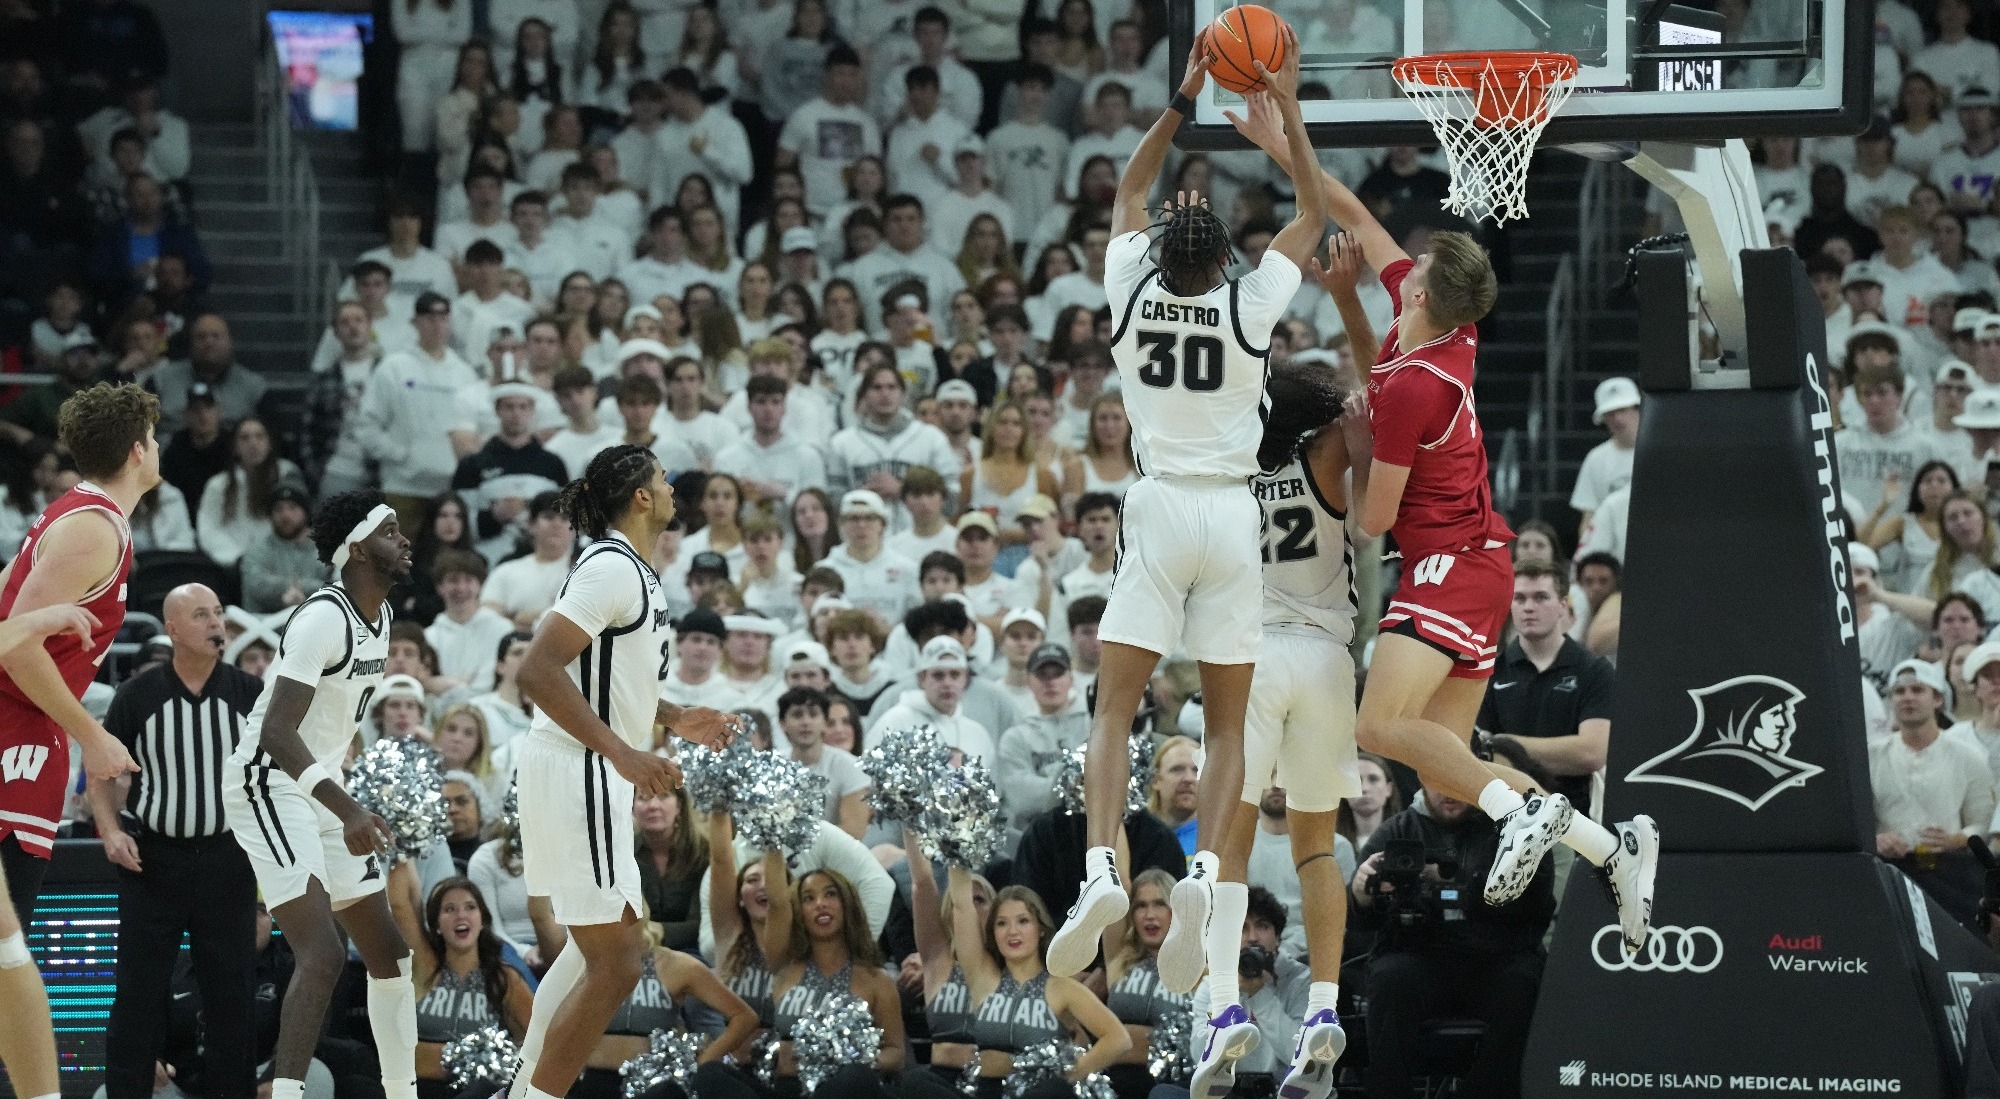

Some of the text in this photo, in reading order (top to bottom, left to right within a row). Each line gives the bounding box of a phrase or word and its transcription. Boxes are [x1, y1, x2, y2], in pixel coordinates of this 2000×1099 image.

[1141, 299, 1220, 327] CASTRO
[1135, 328, 1226, 393] 30
[1254, 478, 1306, 501] RTER
[1806, 352, 1854, 646] Amica
[1413, 553, 1455, 587] W
[0, 744, 50, 784] W
[1768, 933, 1823, 950] Audi
[1767, 954, 1869, 974] Warwick
[420, 985, 495, 1021] FRIAR
[631, 978, 673, 1009] ARS
[933, 982, 967, 1013] FRI
[1591, 1072, 1901, 1093] RHODE ISLAND MEDICAL IMAGING
